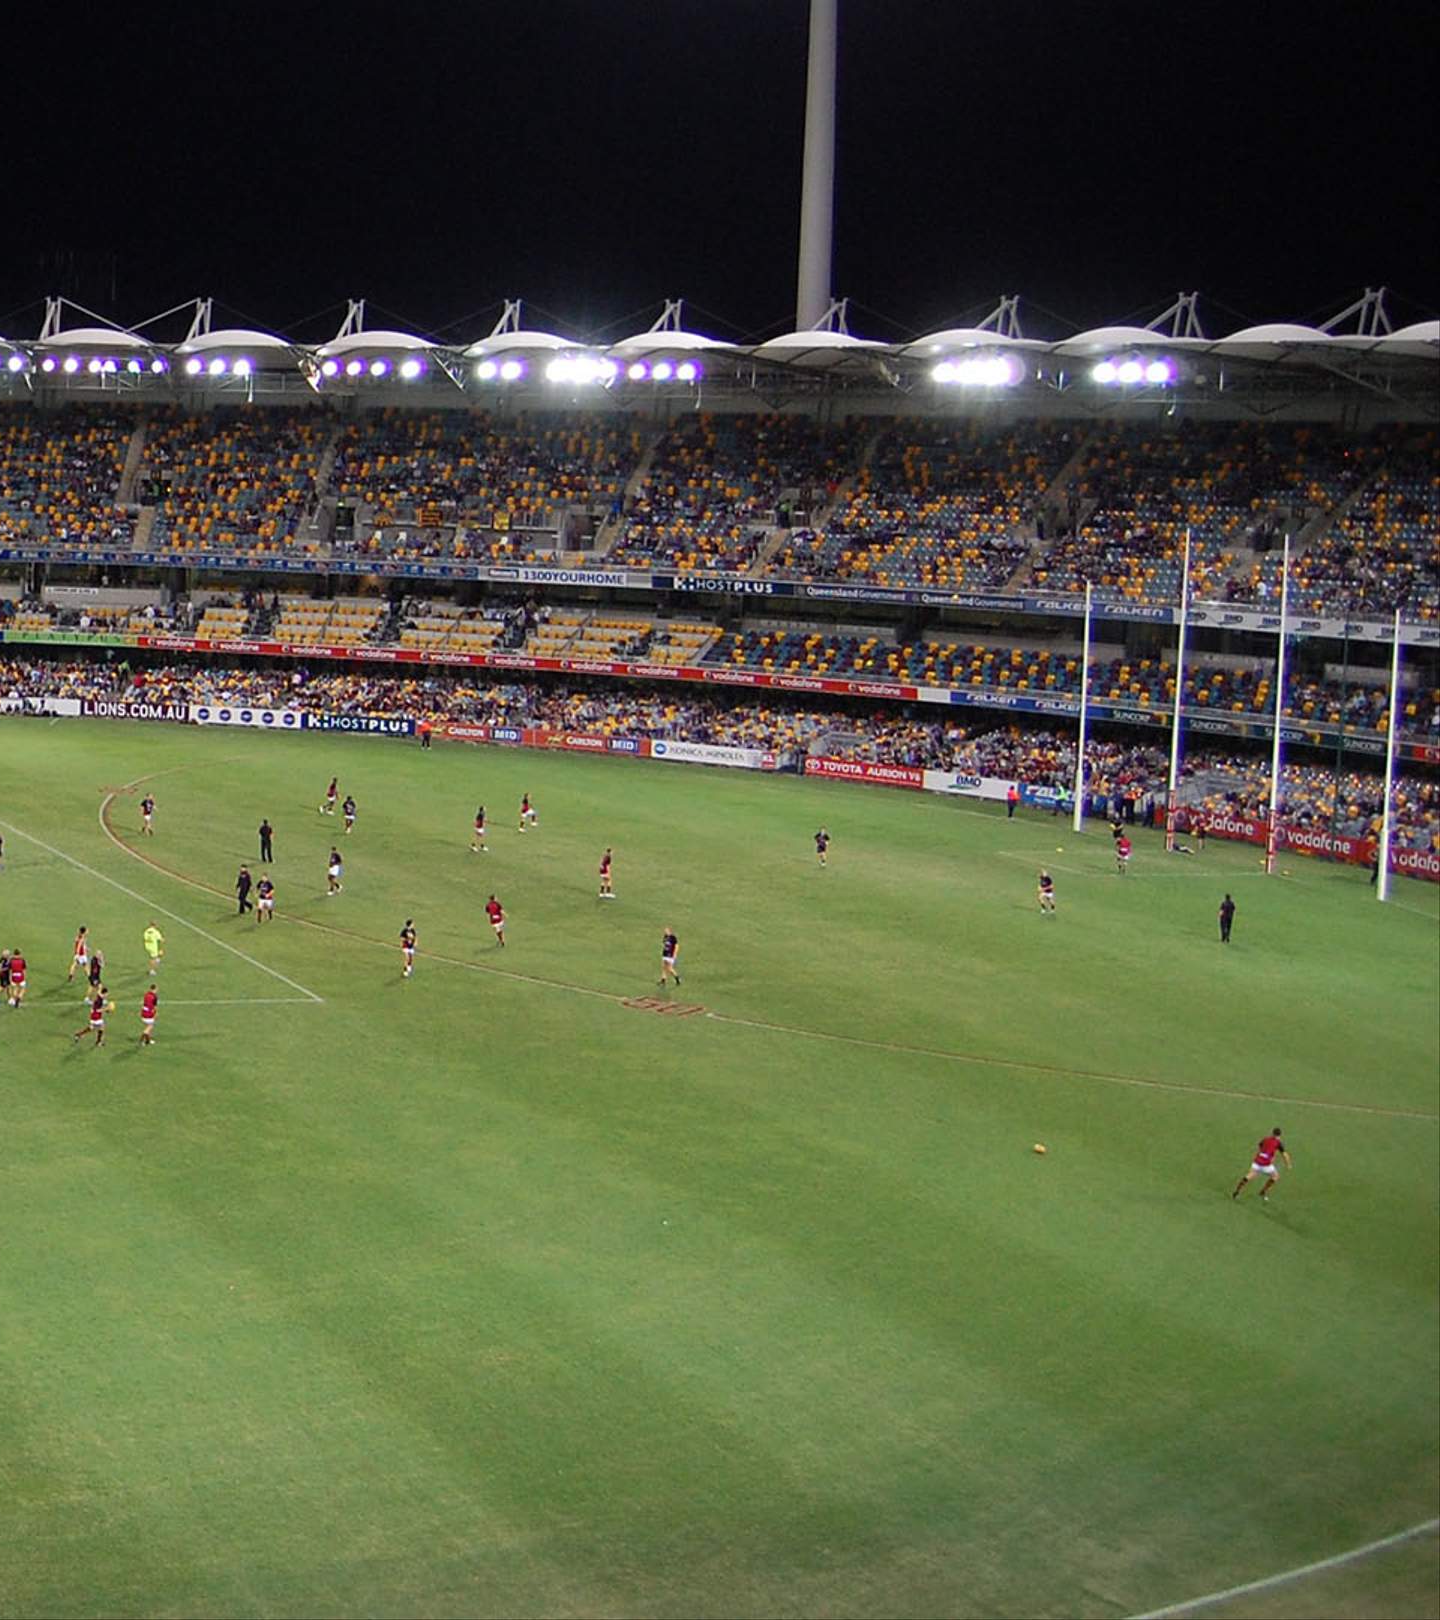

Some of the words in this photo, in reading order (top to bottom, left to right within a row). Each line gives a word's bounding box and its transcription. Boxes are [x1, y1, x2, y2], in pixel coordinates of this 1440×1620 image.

[523, 570, 625, 584] 1300YOURHOME
[696, 579, 773, 594] HOSTPLUS
[806, 585, 859, 599] Queensland
[859, 588, 905, 601] Government
[921, 594, 975, 606] Queenand
[975, 599, 1023, 609] Government
[1104, 604, 1163, 617] FALKEN
[156, 639, 195, 649] vodafone
[220, 642, 260, 652] vodafone
[291, 646, 332, 655] vodafone
[356, 649, 396, 659] vodafone
[430, 653, 470, 662] vodafone
[494, 657, 536, 667] vodafone
[571, 661, 612, 672] vodafone
[635, 666, 678, 677] vodafone
[712, 671, 754, 683] vodafone
[780, 676, 822, 688] vodafone
[858, 683, 901, 695] vodafone
[965, 692, 1017, 705] FALKEN
[83, 701, 185, 720] LIONS.COM.AU
[1112, 709, 1151, 722] SUNCORP
[330, 717, 409, 733] HOSTPLUS
[1265, 727, 1303, 740] SCORP
[823, 760, 862, 775] TOYOTA
[866, 766, 907, 779] AURION
[908, 771, 921, 782] V6
[1188, 815, 1254, 836] vdafone
[1287, 829, 1351, 854] vodafone
